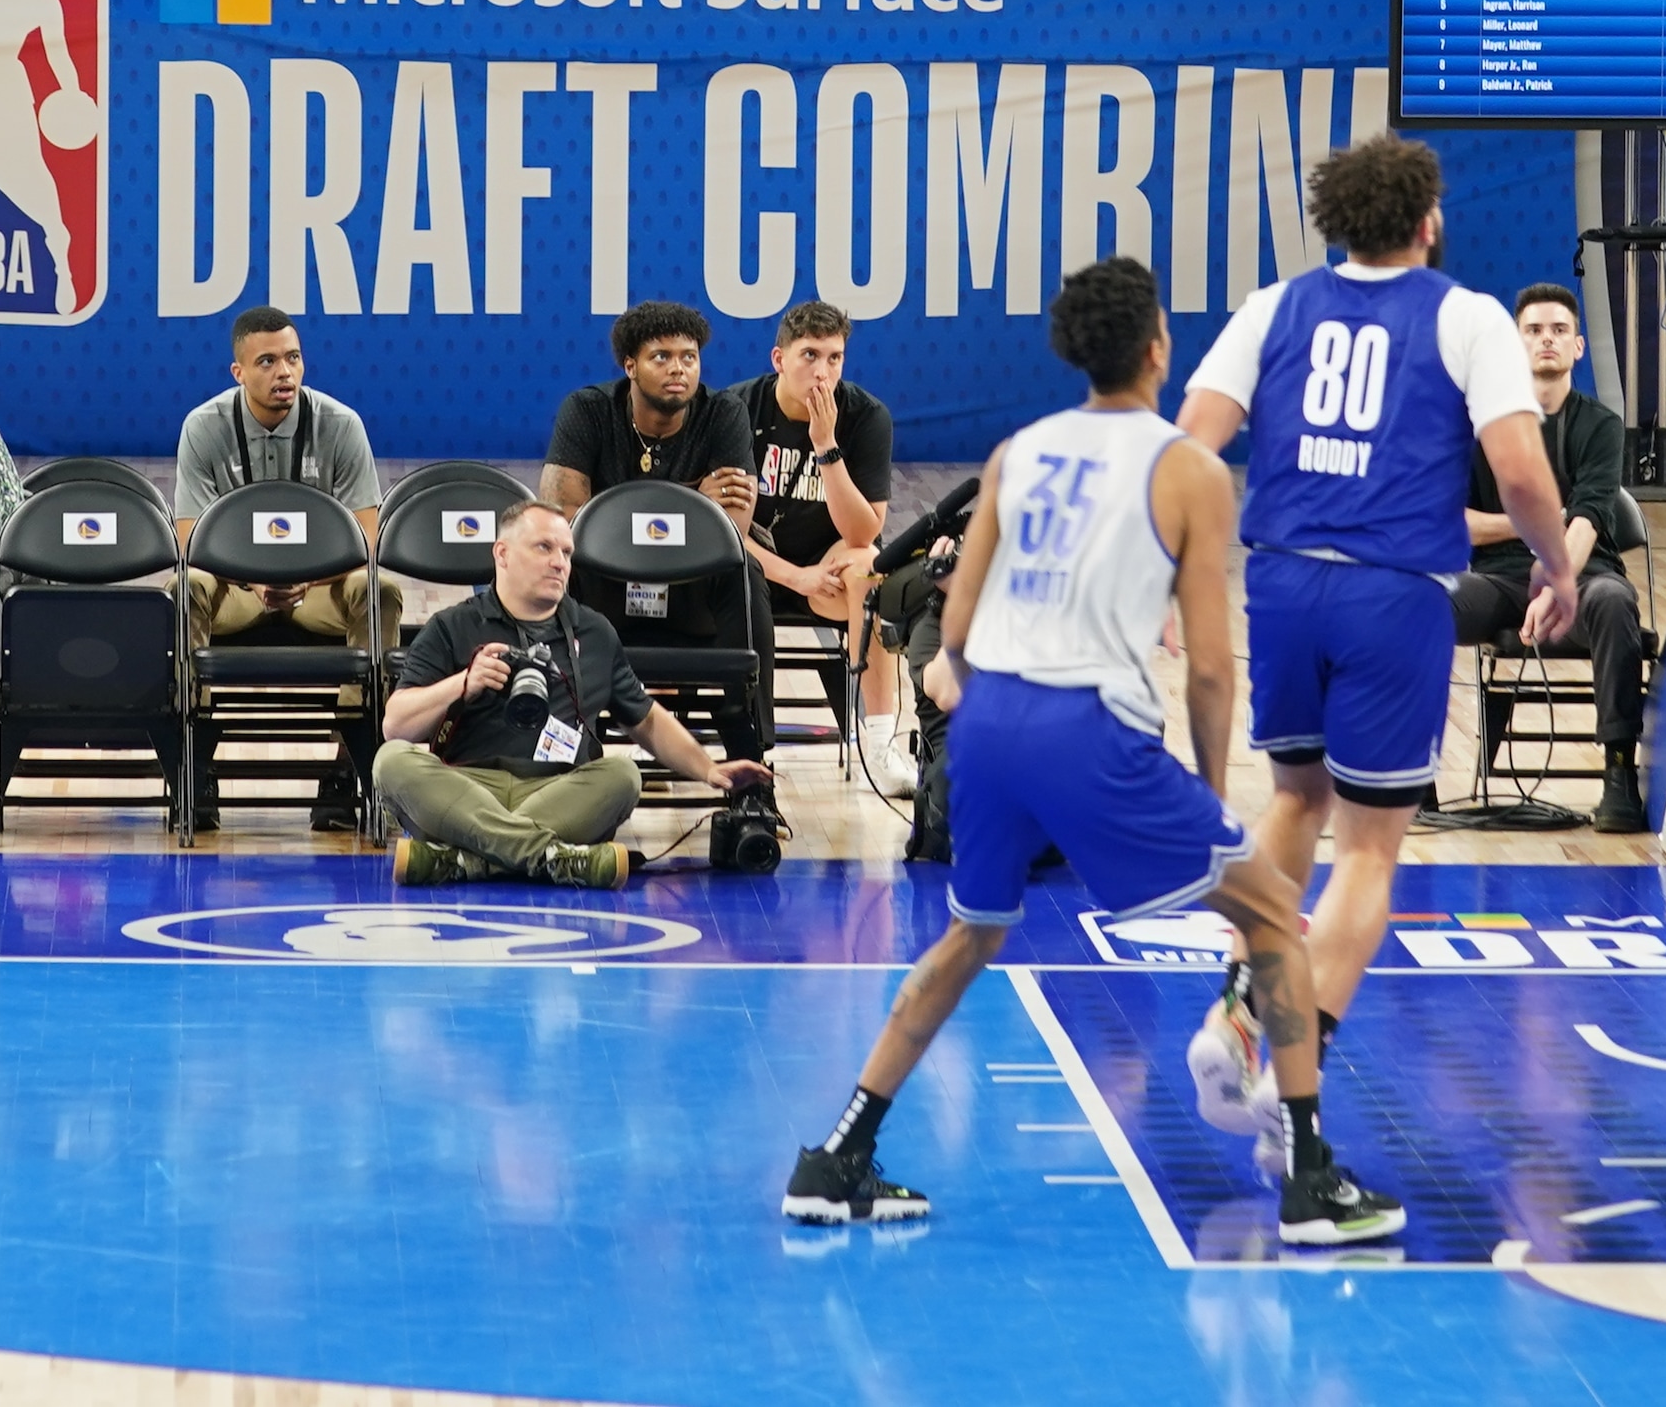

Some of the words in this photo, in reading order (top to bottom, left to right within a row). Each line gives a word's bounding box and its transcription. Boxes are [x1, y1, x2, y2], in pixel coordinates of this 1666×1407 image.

[1440, 19, 1446, 30] 6
[1440, 39, 1445, 50] 7
[1439, 79, 1445, 90] 9
[158, 59, 657, 319] DRAFT
[1302, 320, 1390, 433] 80
[1298, 434, 1374, 479] RODDY
[1020, 452, 1109, 560] 35
